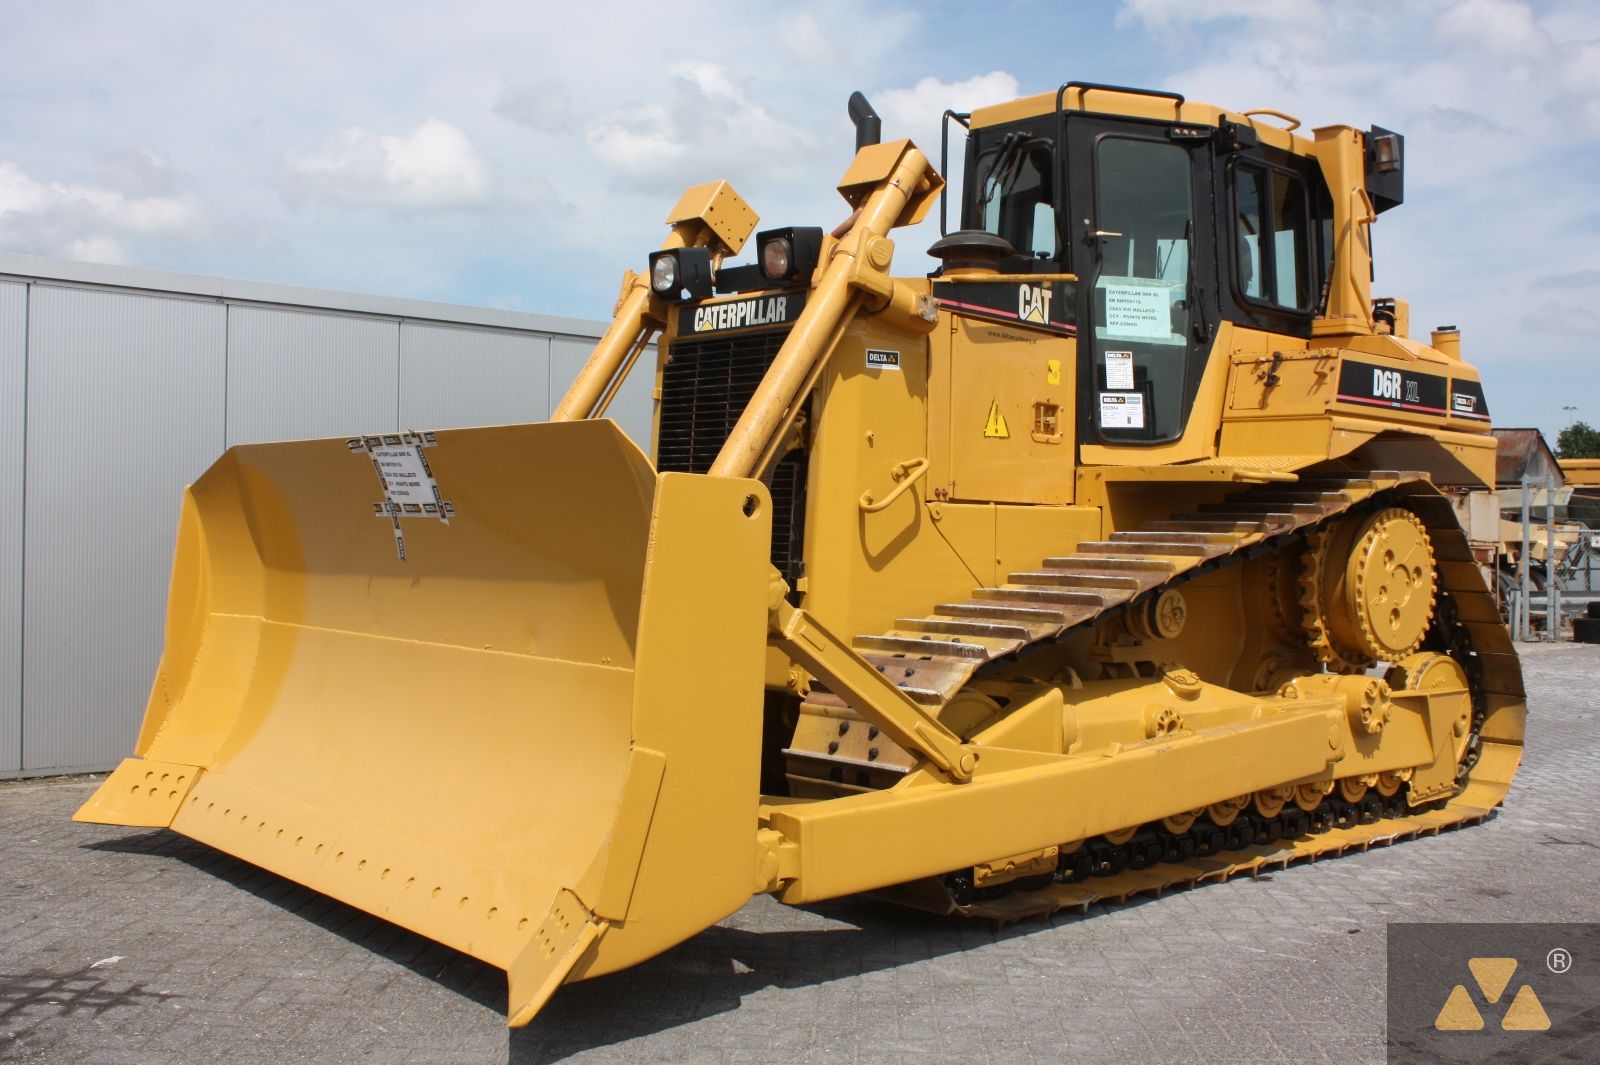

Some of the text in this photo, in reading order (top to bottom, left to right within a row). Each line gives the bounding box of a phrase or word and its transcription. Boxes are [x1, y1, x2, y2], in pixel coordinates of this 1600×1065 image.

[694, 296, 787, 332] CATERPILLAR
[1018, 283, 1052, 325] CAT
[869, 353, 888, 362] DELTA
[1373, 368, 1420, 403] D6R XL
